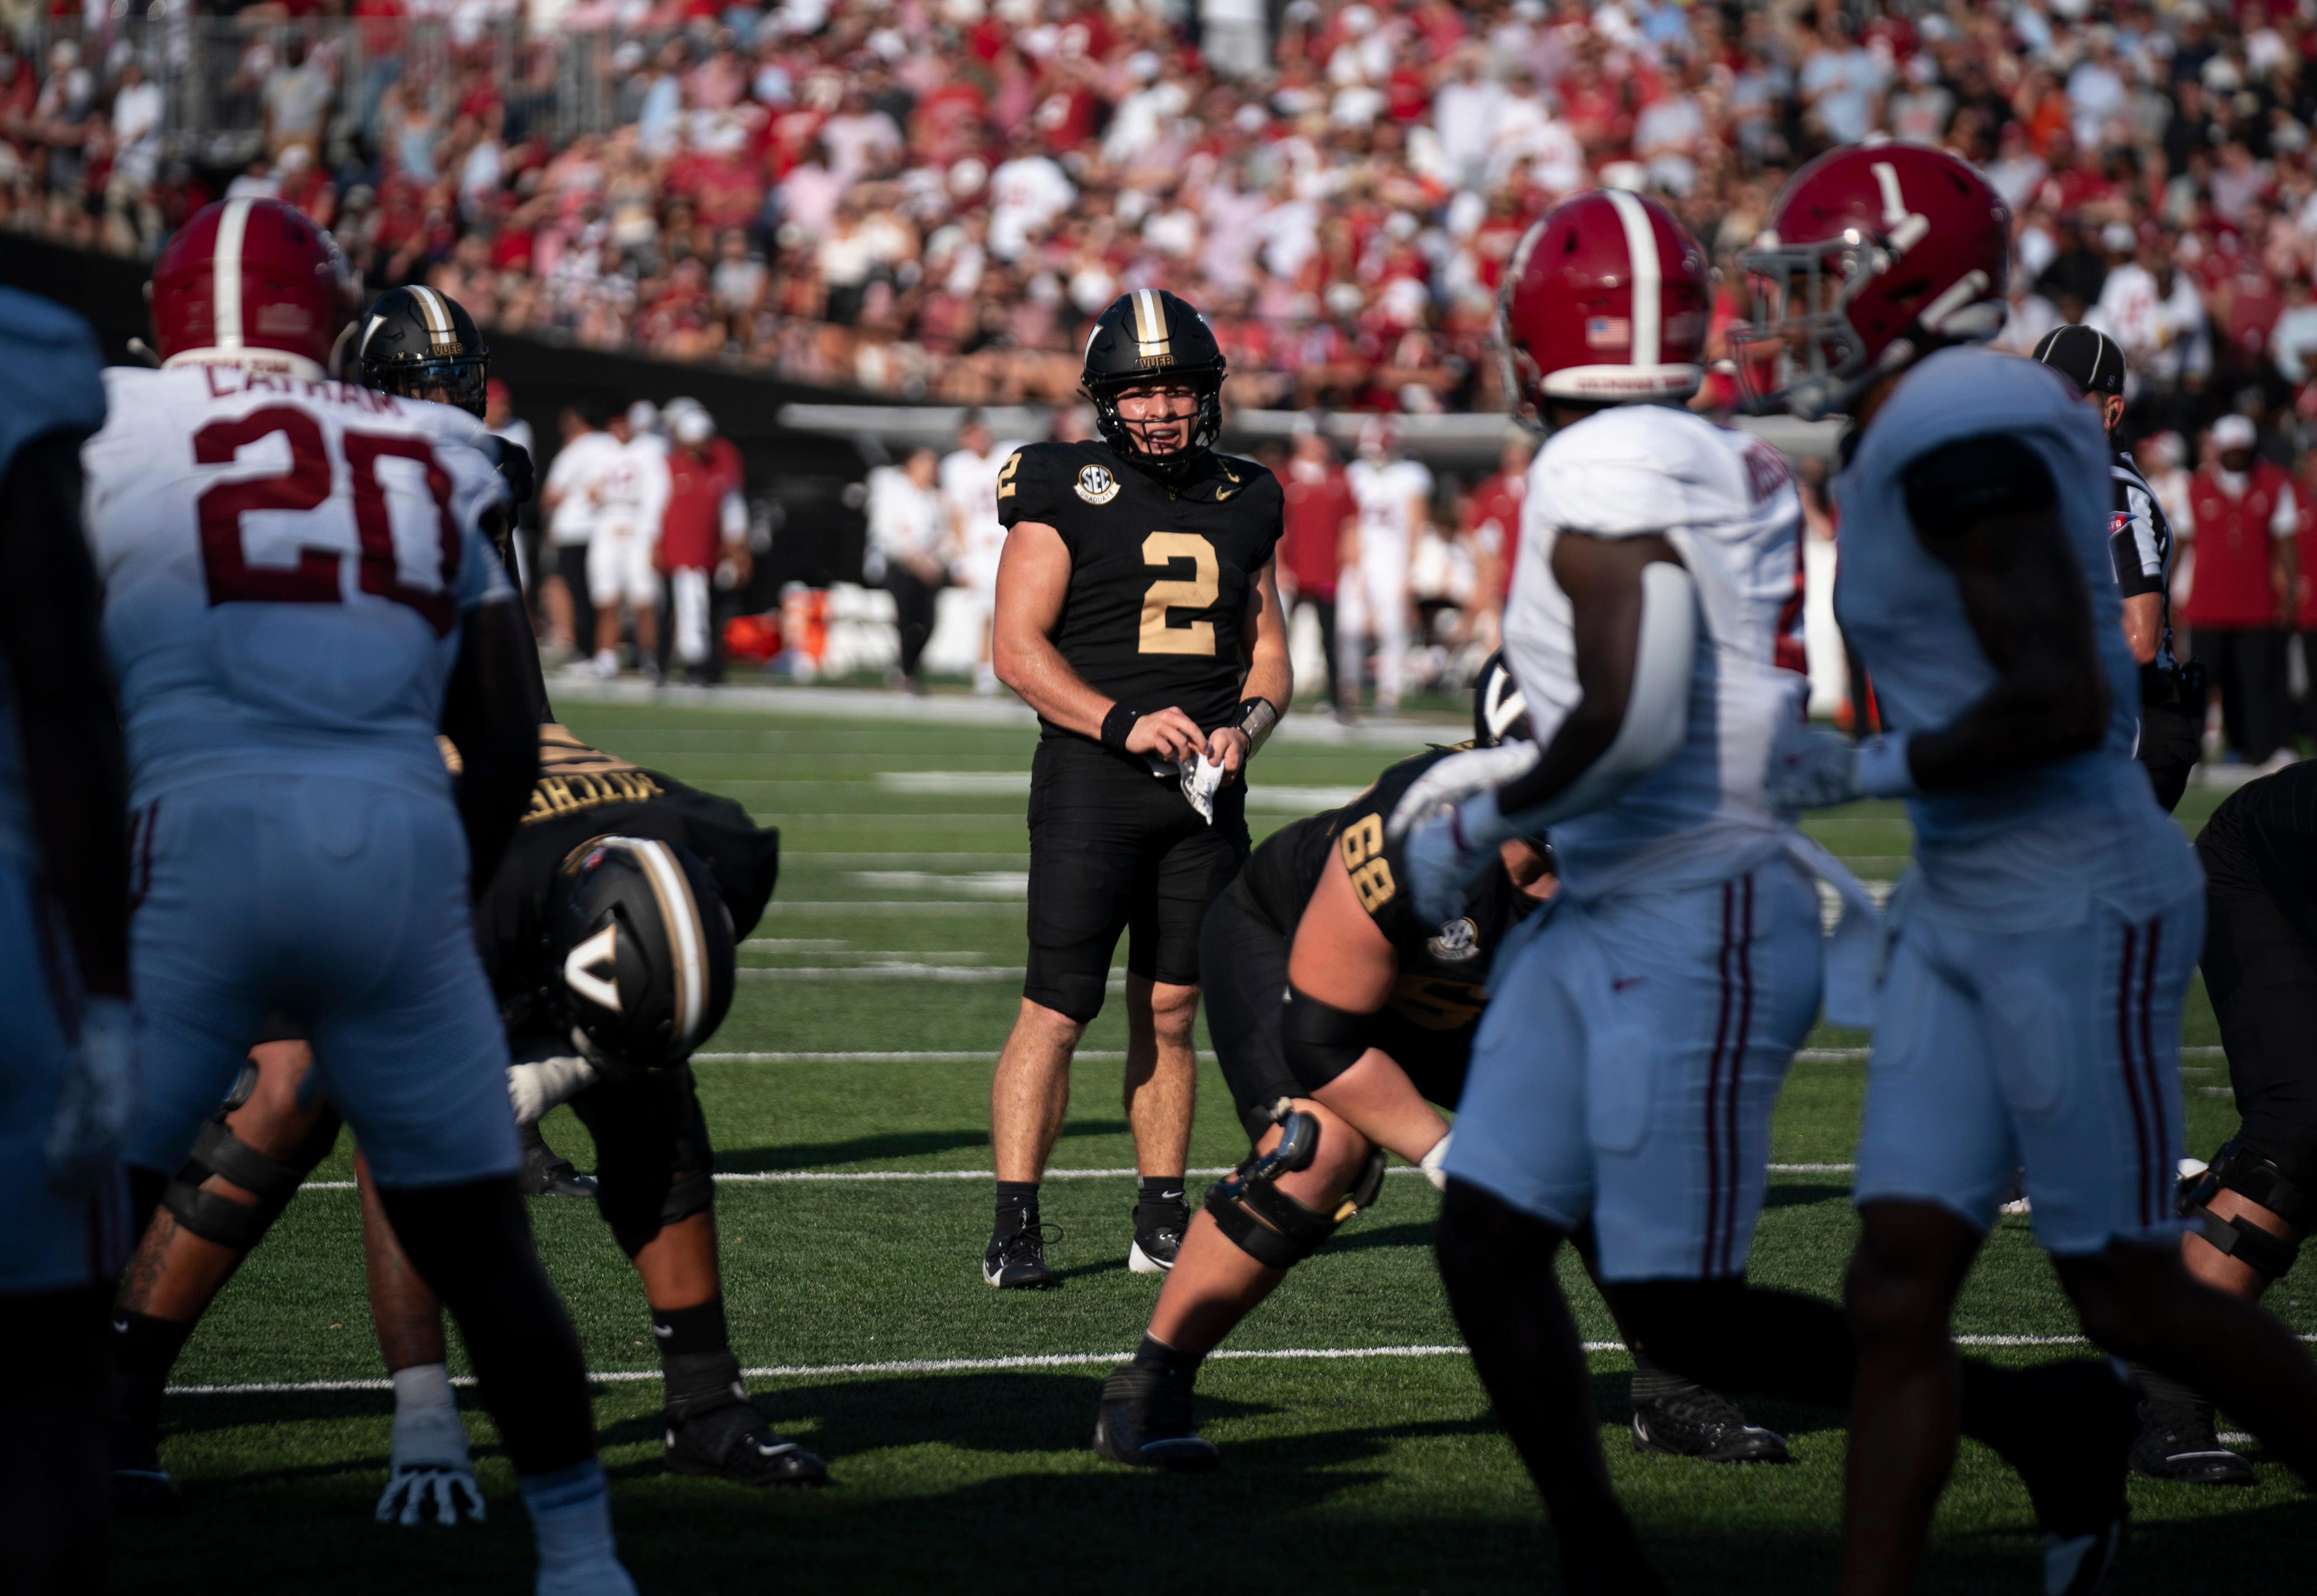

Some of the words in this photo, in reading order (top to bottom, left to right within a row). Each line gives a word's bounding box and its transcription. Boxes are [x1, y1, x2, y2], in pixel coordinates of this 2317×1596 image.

[432, 343, 463, 355] VUFB
[1140, 355, 1174, 368] VUFB
[998, 452, 1023, 500] 2
[1079, 489, 1115, 503] GRADUATE
[1081, 466, 1110, 494] SEC
[193, 404, 461, 642] 20
[1138, 531, 1219, 656] 2
[519, 771, 665, 825] MITCHE
[1341, 812, 1396, 915] 68
